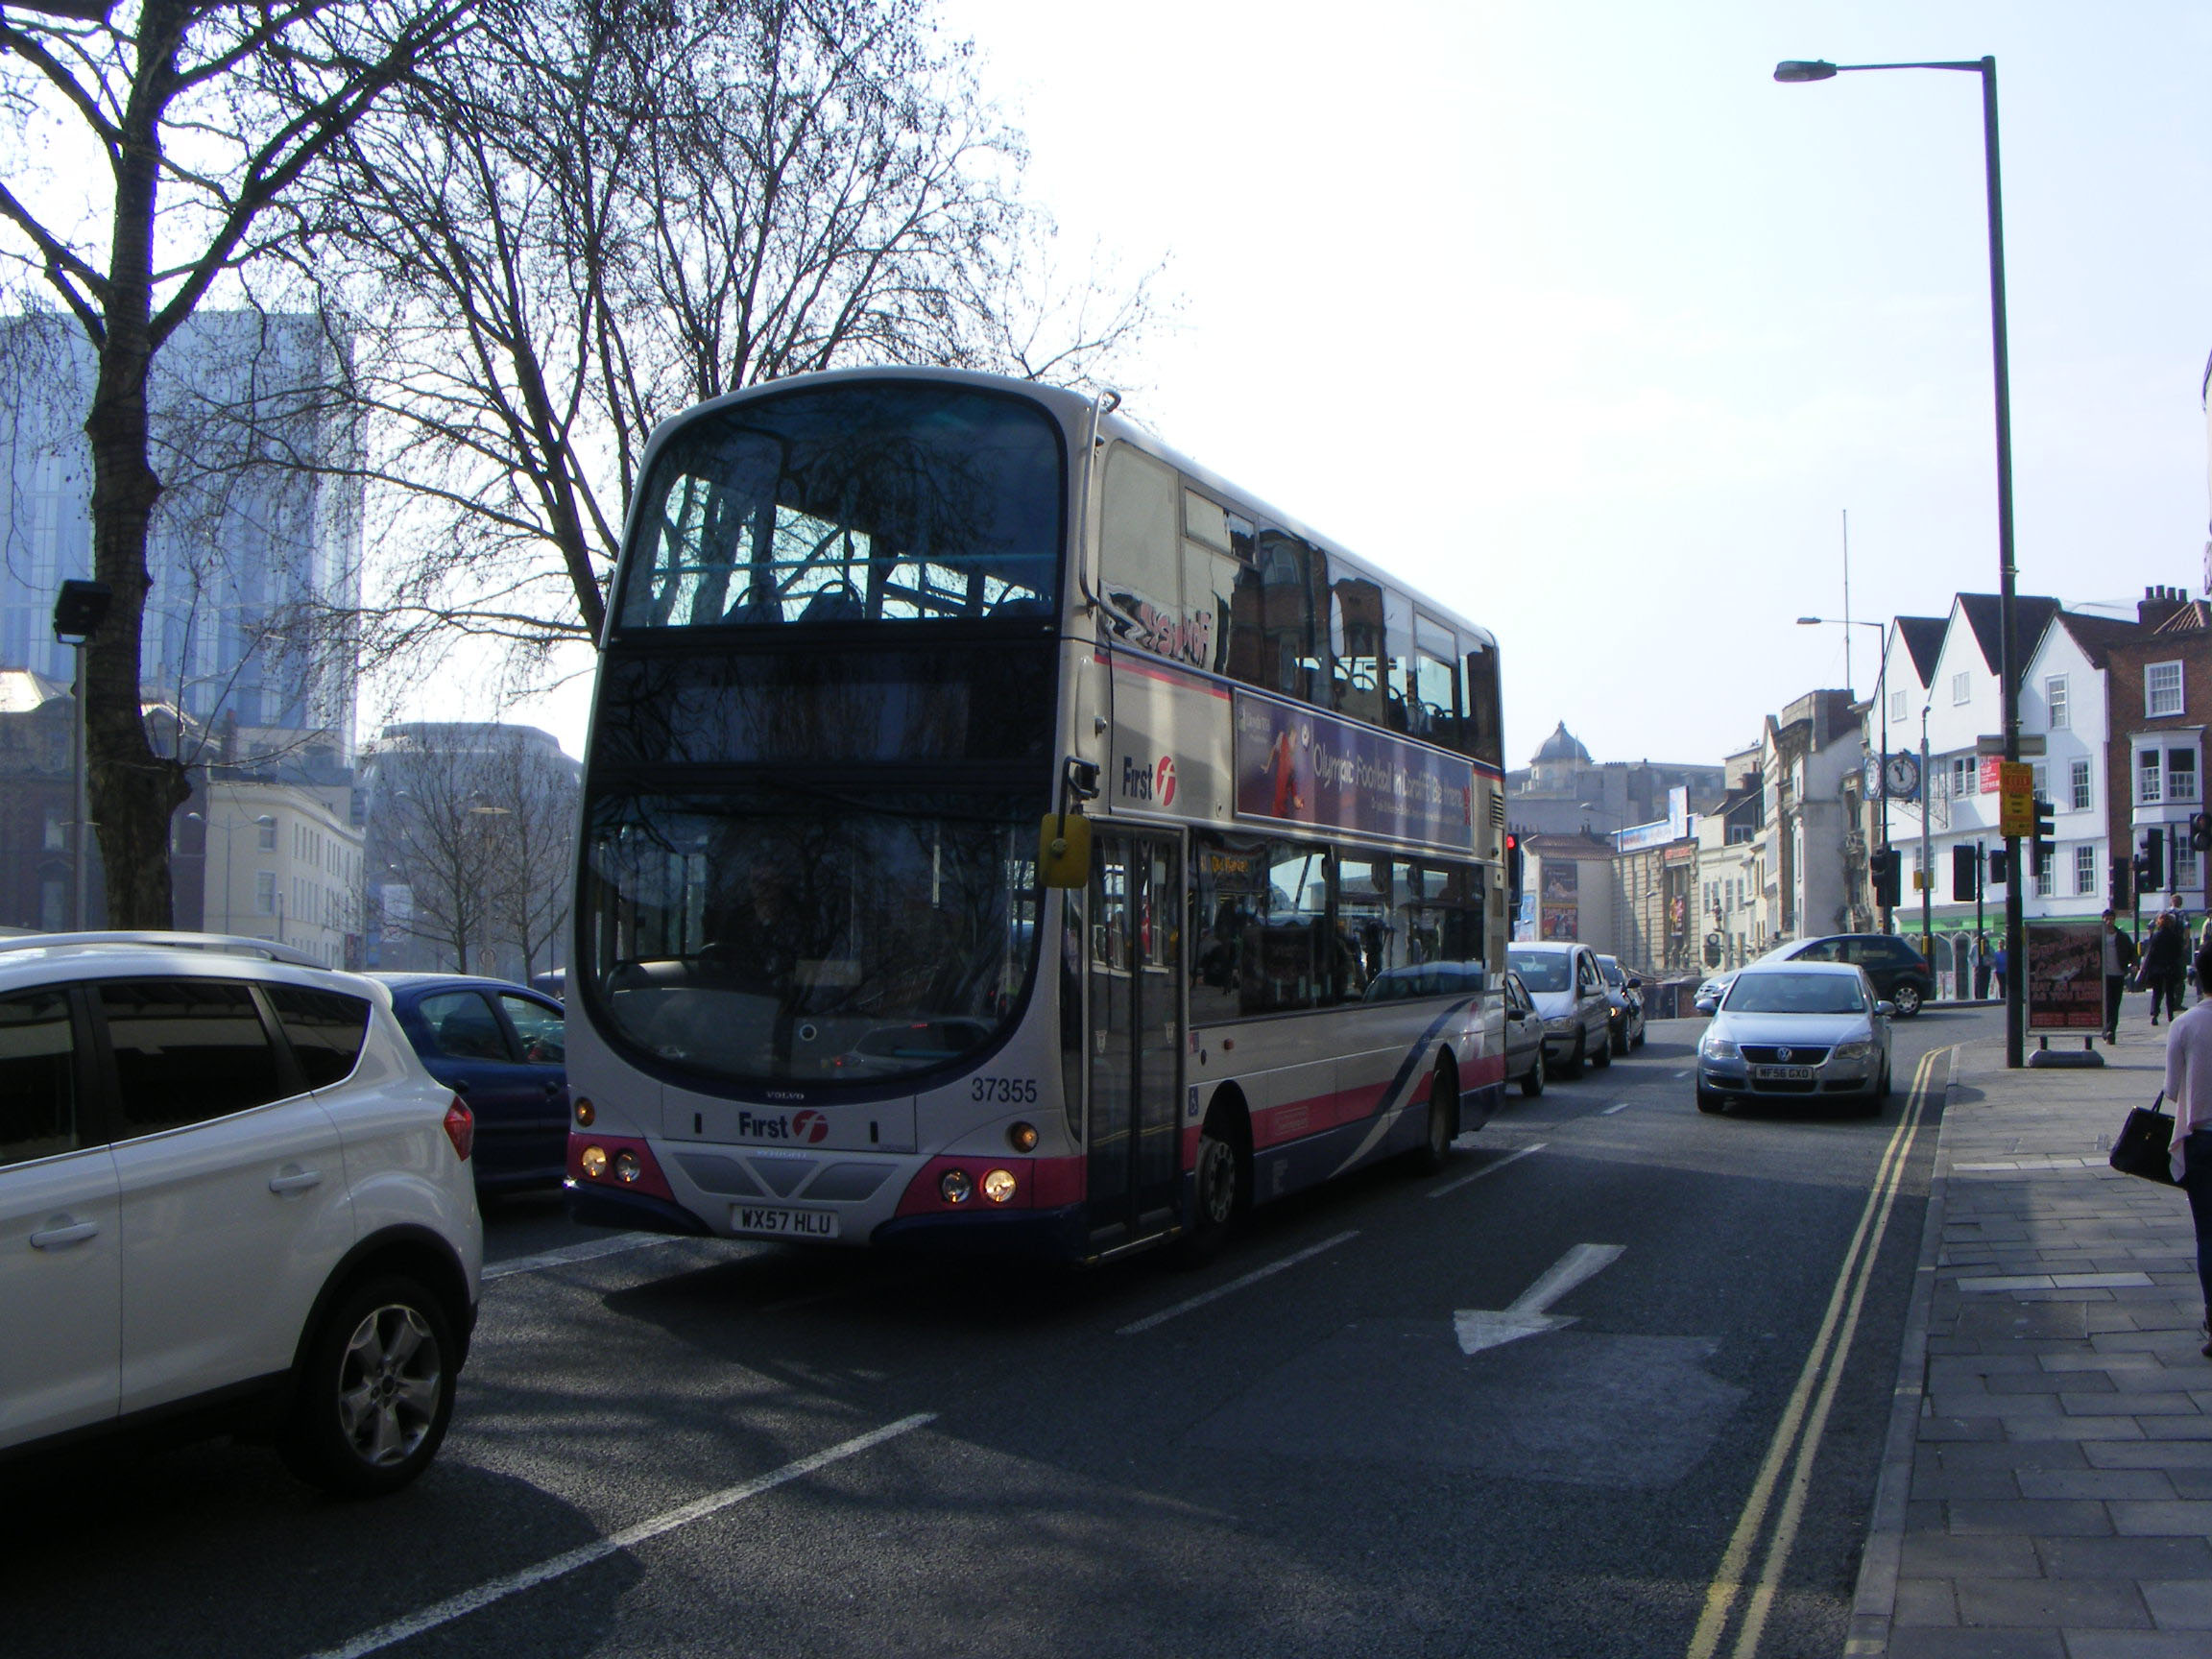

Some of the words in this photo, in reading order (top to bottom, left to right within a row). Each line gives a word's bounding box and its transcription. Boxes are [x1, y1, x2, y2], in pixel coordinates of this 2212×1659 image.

[1122, 755, 1153, 801] First
[1313, 741, 1355, 792] Olympic
[1357, 753, 1392, 794] Football
[766, 1090, 805, 1100] VOLVO
[972, 1077, 1037, 1103] 37355
[738, 1111, 789, 1140] First
[741, 1208, 789, 1231] WX57
[794, 1213, 831, 1235] HLU
